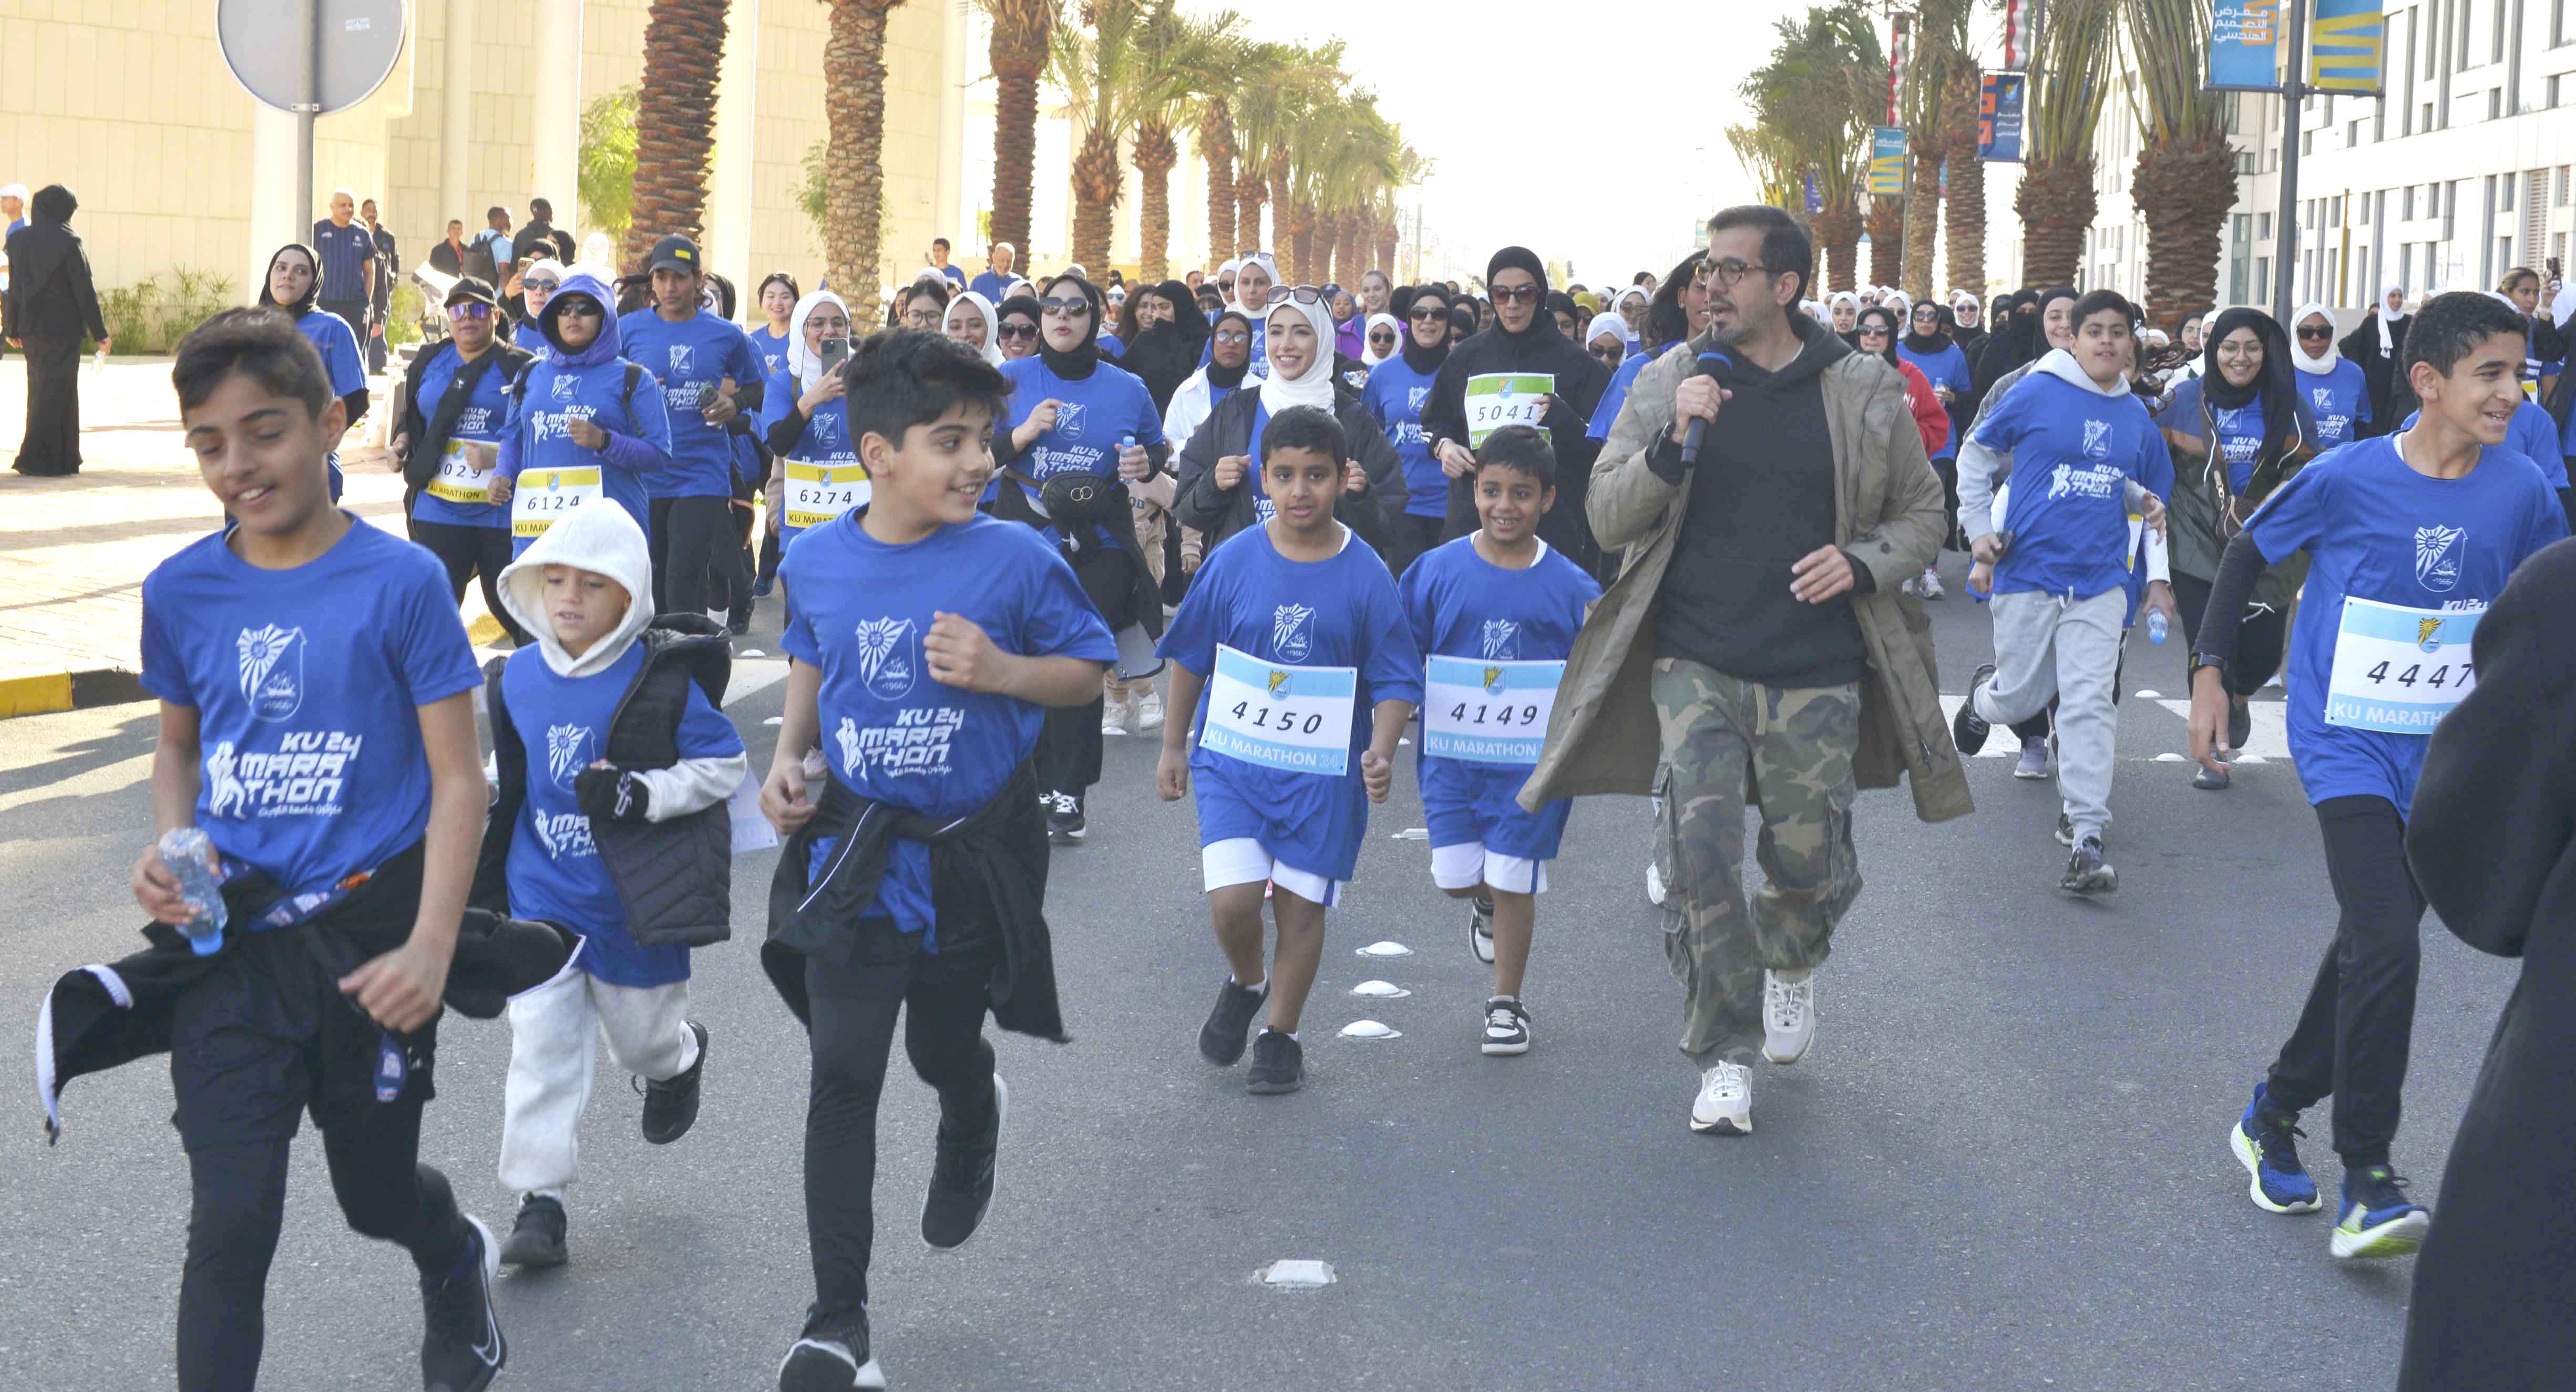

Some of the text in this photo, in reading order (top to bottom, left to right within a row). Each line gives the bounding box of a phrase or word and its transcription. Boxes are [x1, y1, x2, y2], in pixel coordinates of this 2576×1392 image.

[2214, 5, 2267, 17] معرض
[2214, 19, 2267, 30] التصميم
[2214, 32, 2266, 44] الهندسي
[565, 405, 597, 418] KU 24
[1477, 405, 1534, 421] 5041
[457, 421, 486, 430] HON
[2248, 437, 2262, 449] 24
[830, 451, 846, 460] KU
[1048, 451, 1095, 466] MARA
[1070, 446, 1104, 461] KU 24
[2093, 463, 2112, 474] KU
[528, 495, 580, 510] 6124
[800, 489, 852, 504] 6274
[788, 514, 801, 522] KU
[2367, 661, 2473, 688] 4447
[896, 707, 964, 731] KU 24
[1233, 702, 1322, 734] 4150
[1451, 702, 1537, 725] 4149
[2334, 702, 2446, 726] KU MARATH
[859, 725, 953, 748] MARA
[280, 731, 362, 760] KU 24
[1209, 728, 1228, 745] KU
[1230, 738, 1317, 766] MARATHON
[1430, 737, 1536, 756] KU MARATHON
[865, 744, 950, 767] THON
[239, 752, 347, 779] MARA
[243, 778, 343, 805] THON
